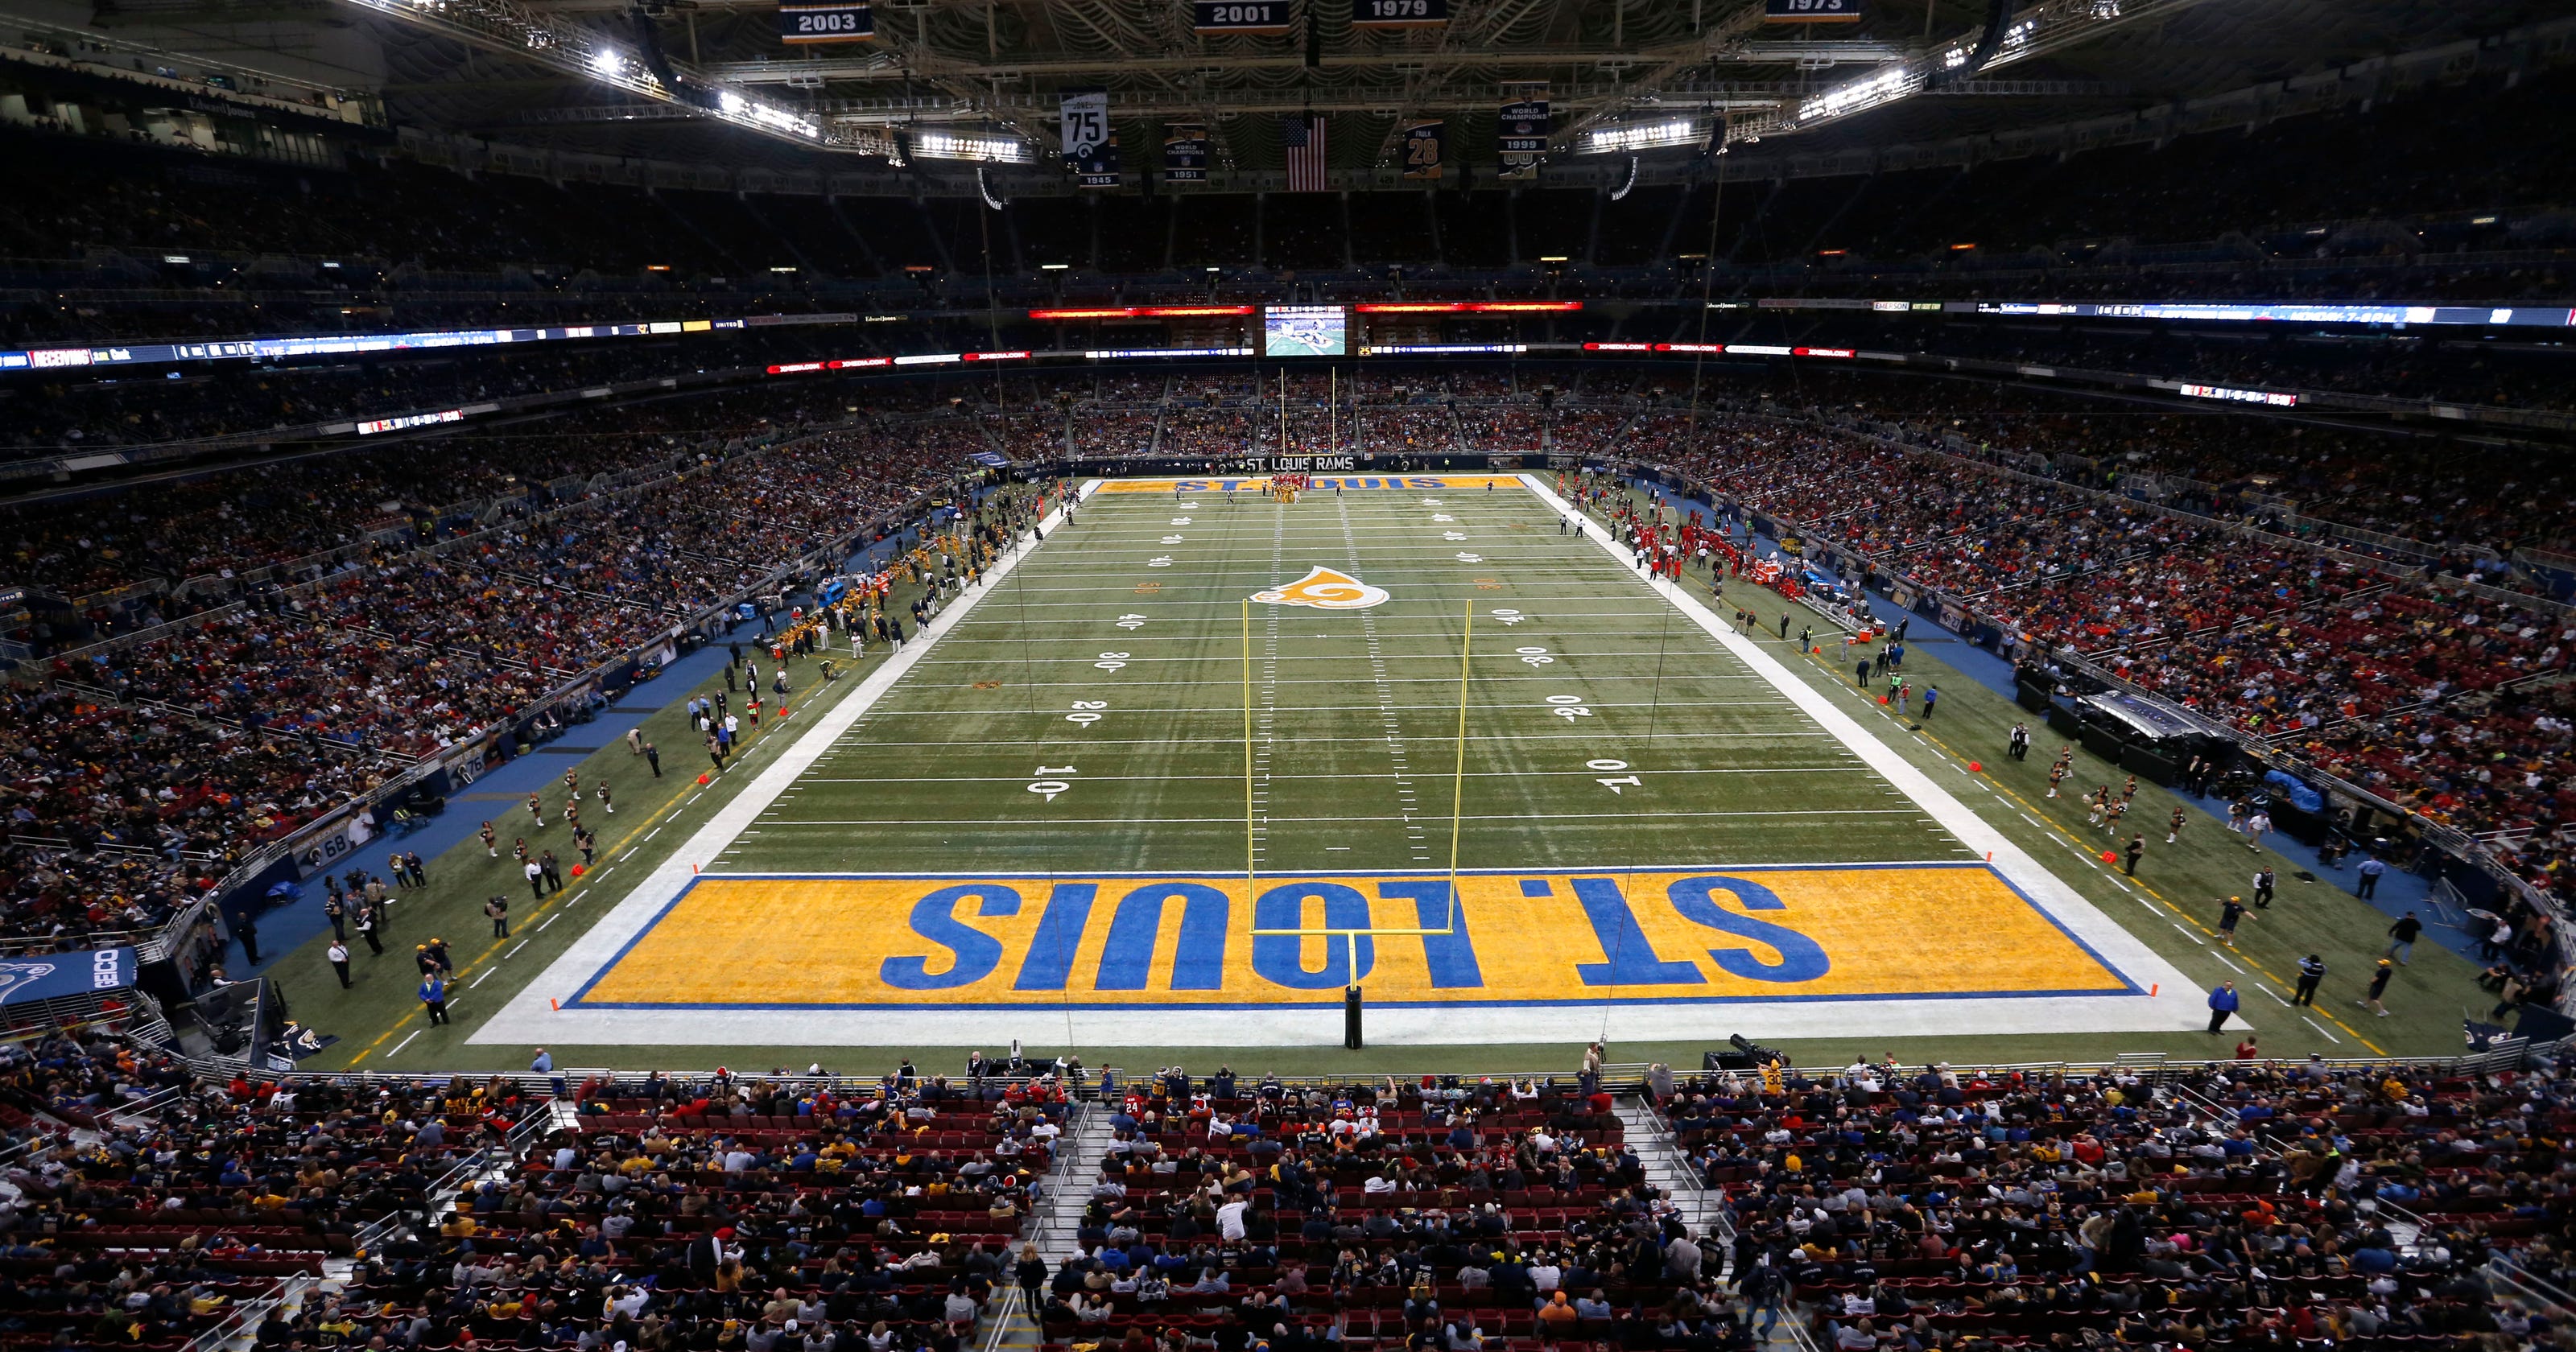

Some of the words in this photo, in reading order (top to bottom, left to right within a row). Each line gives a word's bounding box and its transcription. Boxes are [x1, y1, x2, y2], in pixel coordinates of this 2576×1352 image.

[1213, 6, 1270, 23] 2001
[1372, 0, 1427, 16] 1979
[799, 14, 856, 31] 2003
[1068, 113, 1100, 142] 75
[1408, 138, 1439, 165] 28
[1507, 140, 1537, 149] 1999
[33, 348, 89, 367] RECEIVING
[1360, 347, 1370, 355] 25
[1247, 458, 1266, 471] ST.
[1272, 458, 1311, 471] LOUIS
[1316, 457, 1354, 470] RAMS
[1174, 480, 1253, 490] ST.
[1288, 478, 1447, 489] OUIS
[1133, 583, 1161, 593] 50
[1472, 579, 1502, 589] 50
[1116, 614, 1147, 627] 40
[1491, 608, 1525, 622] 40
[1093, 652, 1130, 669] 30
[1515, 647, 1554, 663] 30
[1065, 700, 1108, 722] 20
[1546, 695, 1593, 716] 20
[468, 757, 482, 775] 76
[1586, 759, 1642, 786] 10
[1027, 765, 1078, 793] 10
[324, 835, 346, 858] 68
[880, 880, 1484, 990] LOUIS
[1519, 876, 1831, 986] ST.
[93, 949, 120, 989] GEICO
[1768, 1075, 1781, 1086] 30
[1152, 1083, 1165, 1095] 80
[1126, 1103, 1138, 1113] 24
[2048, 1112, 2063, 1122] 39
